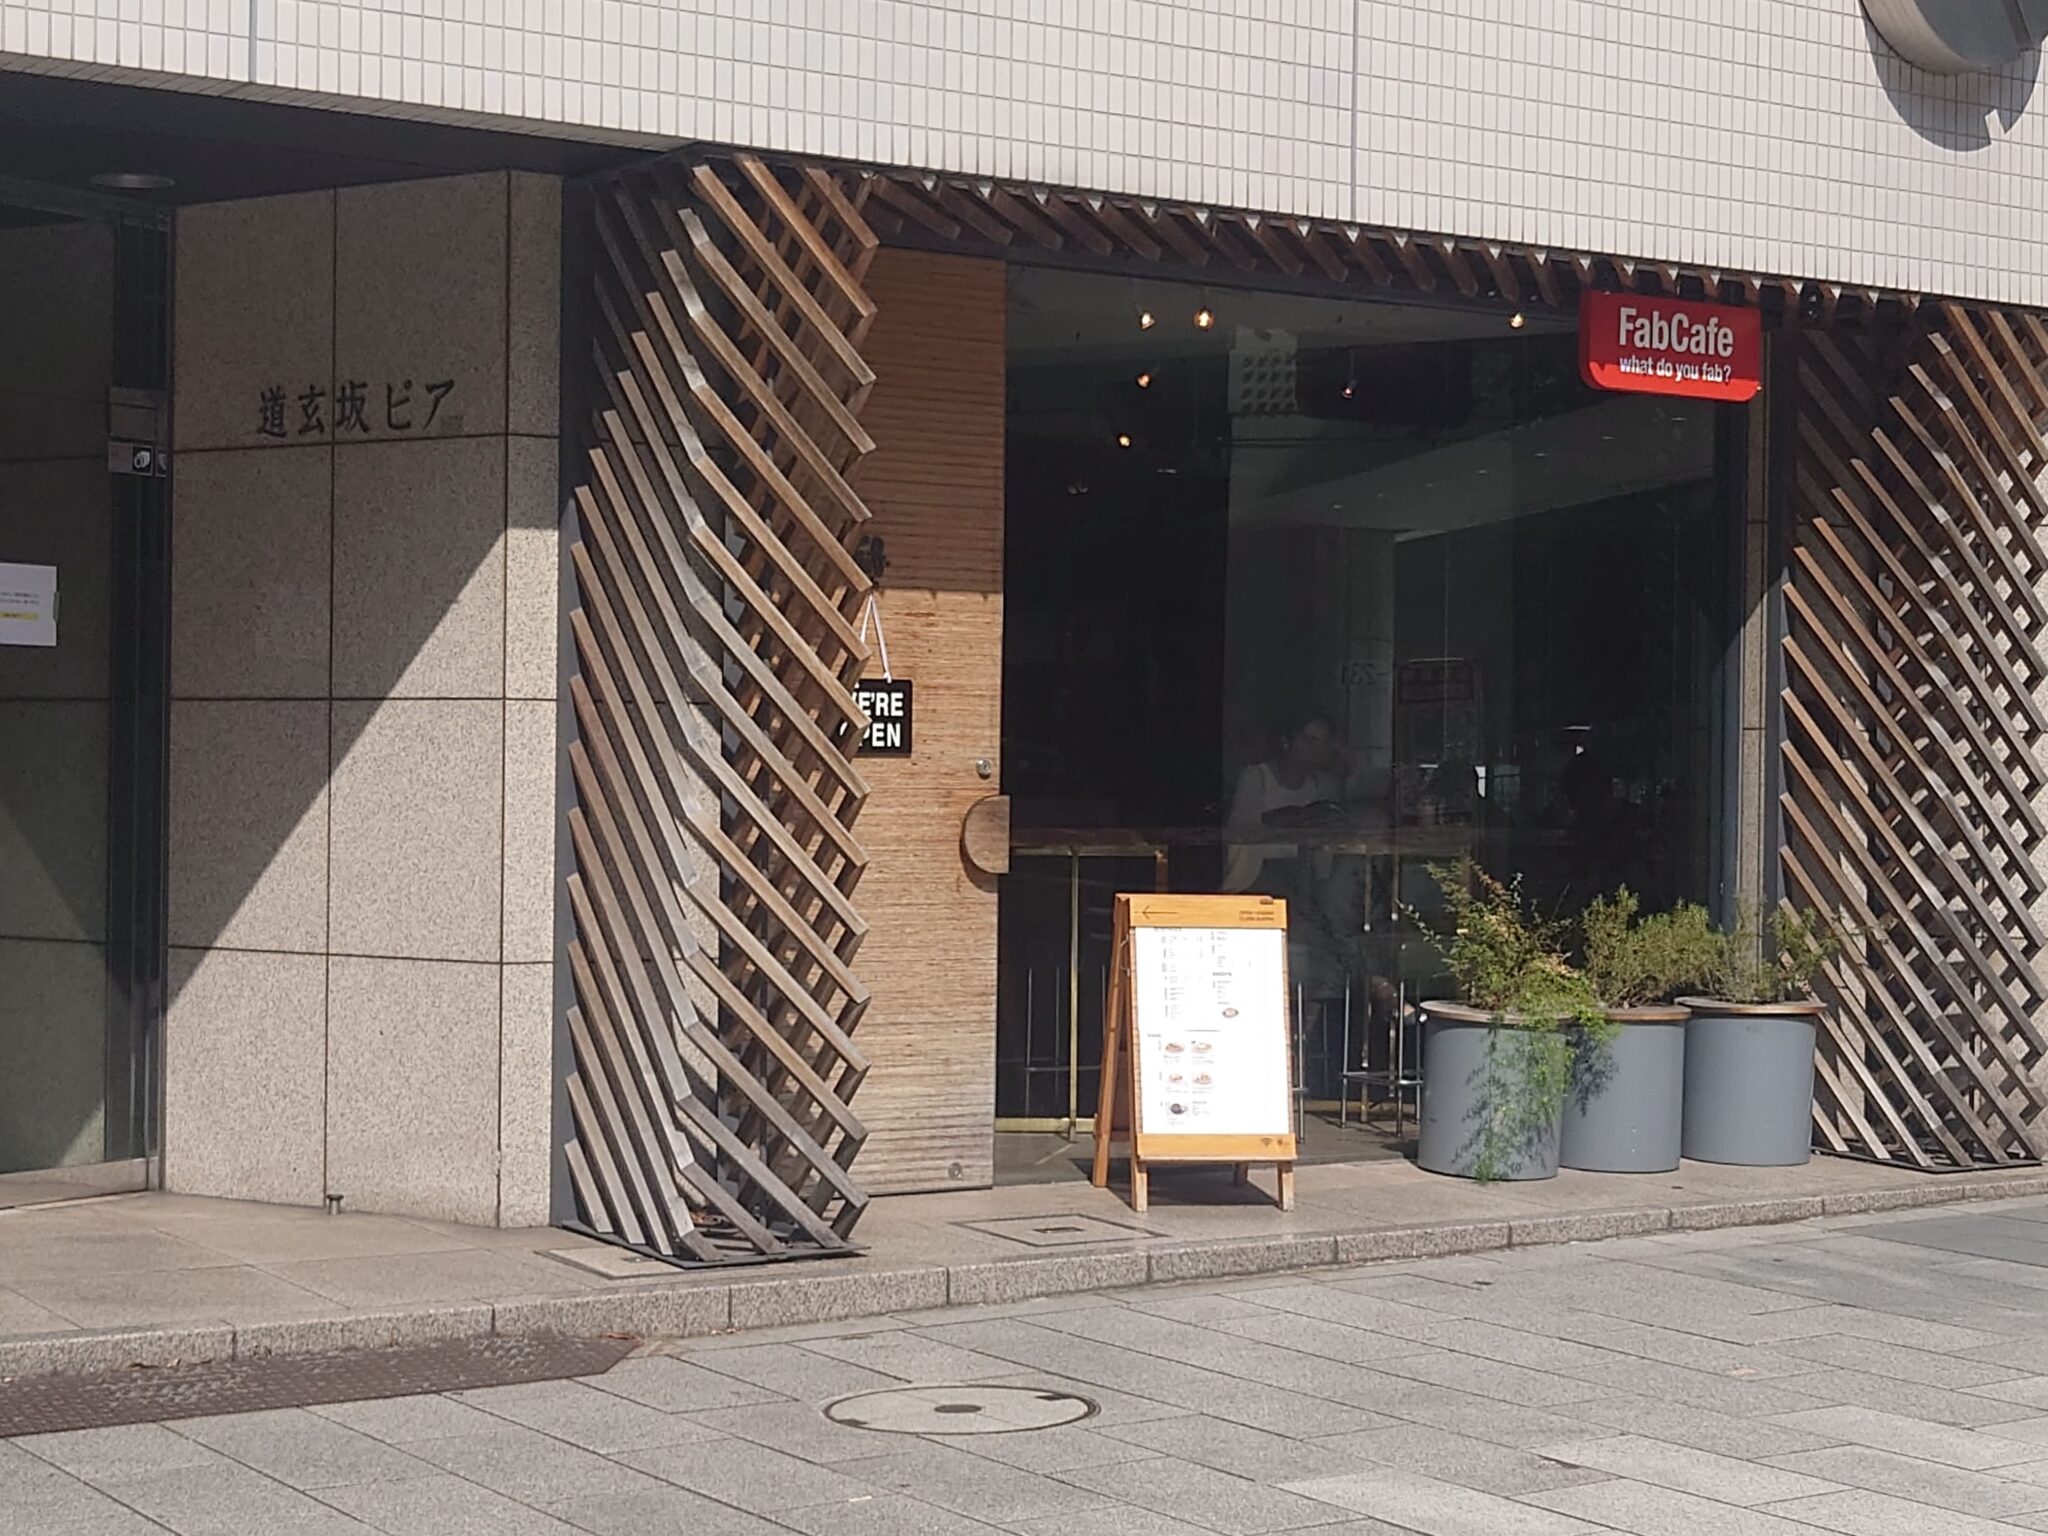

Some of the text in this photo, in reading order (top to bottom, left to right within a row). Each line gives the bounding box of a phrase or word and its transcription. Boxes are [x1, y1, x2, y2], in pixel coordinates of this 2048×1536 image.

[1619, 306, 1734, 357] FabCafe
[1619, 354, 1732, 382] what do you fab?
